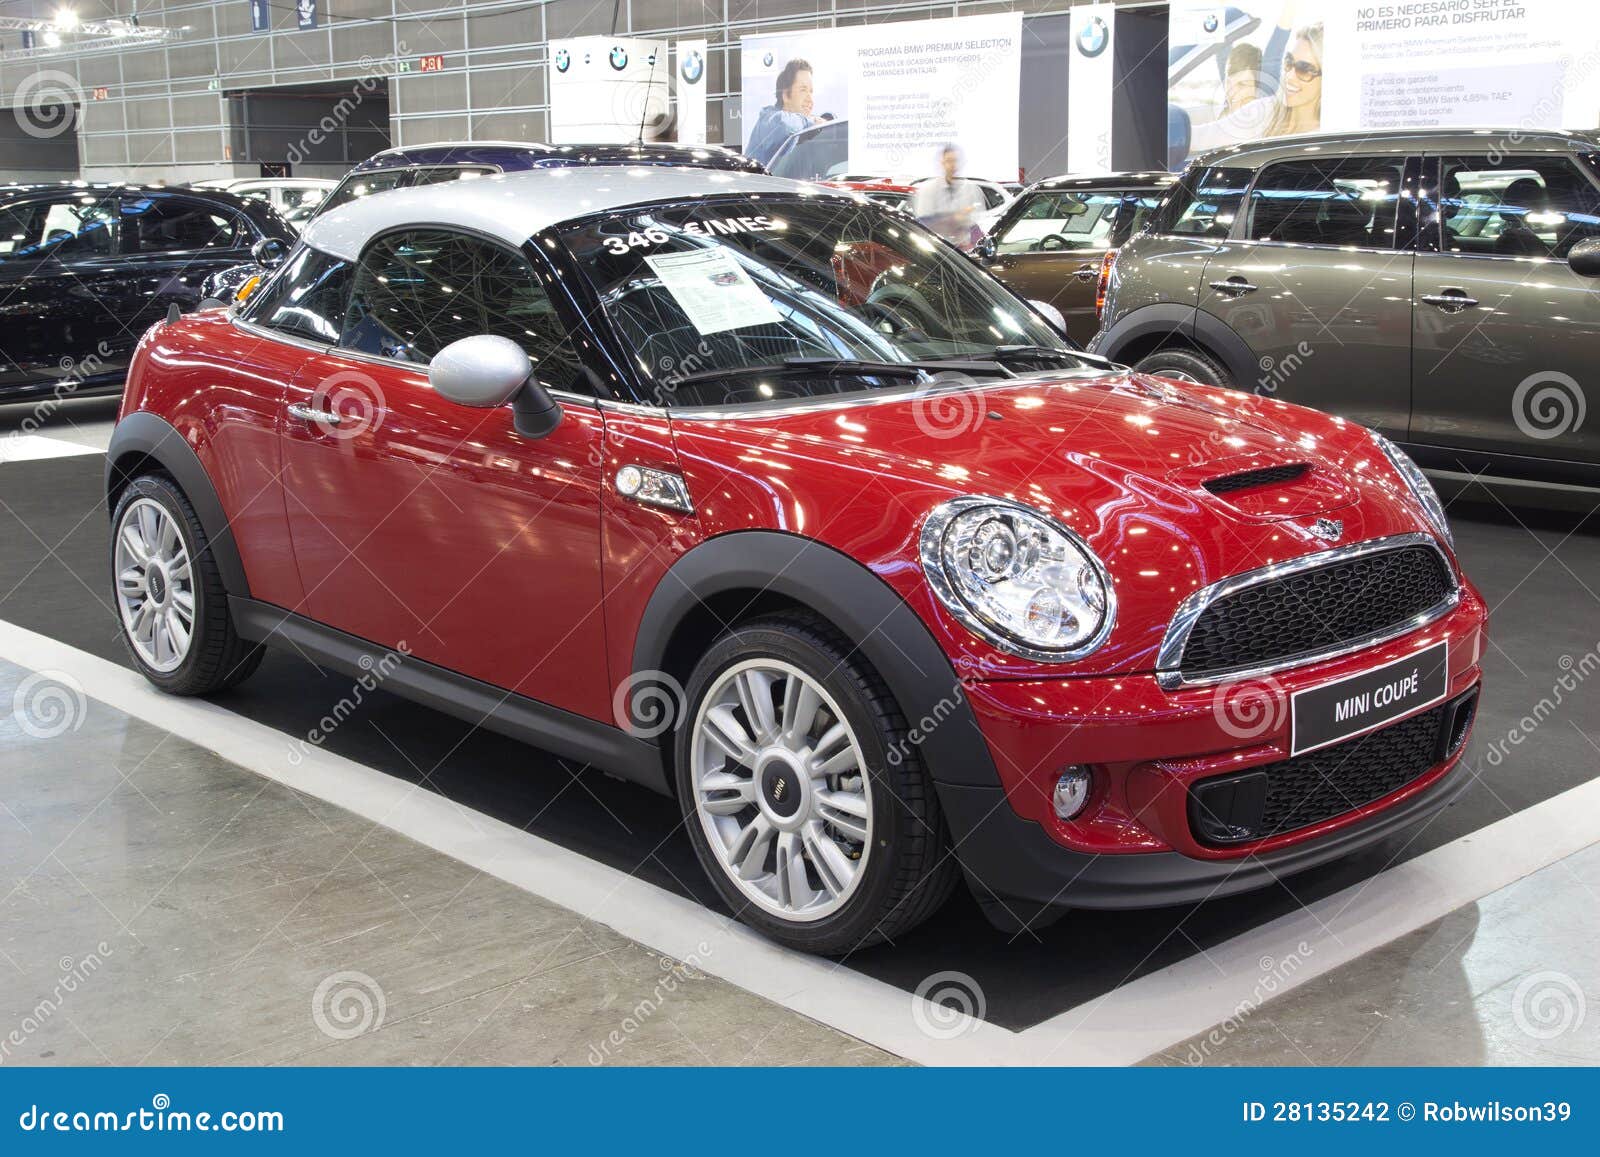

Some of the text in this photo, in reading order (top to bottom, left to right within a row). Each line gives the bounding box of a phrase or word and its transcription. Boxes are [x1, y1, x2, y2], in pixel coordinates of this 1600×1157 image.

[1357, 8, 1375, 19] NO
[1378, 7, 1394, 17] ES
[1397, 0, 1470, 16] NECESARIO
[1357, 8, 1526, 31] PRIMERO PARA DISFRUTAR
[858, 38, 1012, 57] PROGRAMA BMW PREMIUM SELECTION
[602, 225, 670, 255] 346
[1335, 668, 1418, 722] MINI COUPÉ
[773, 778, 786, 801] MINI
